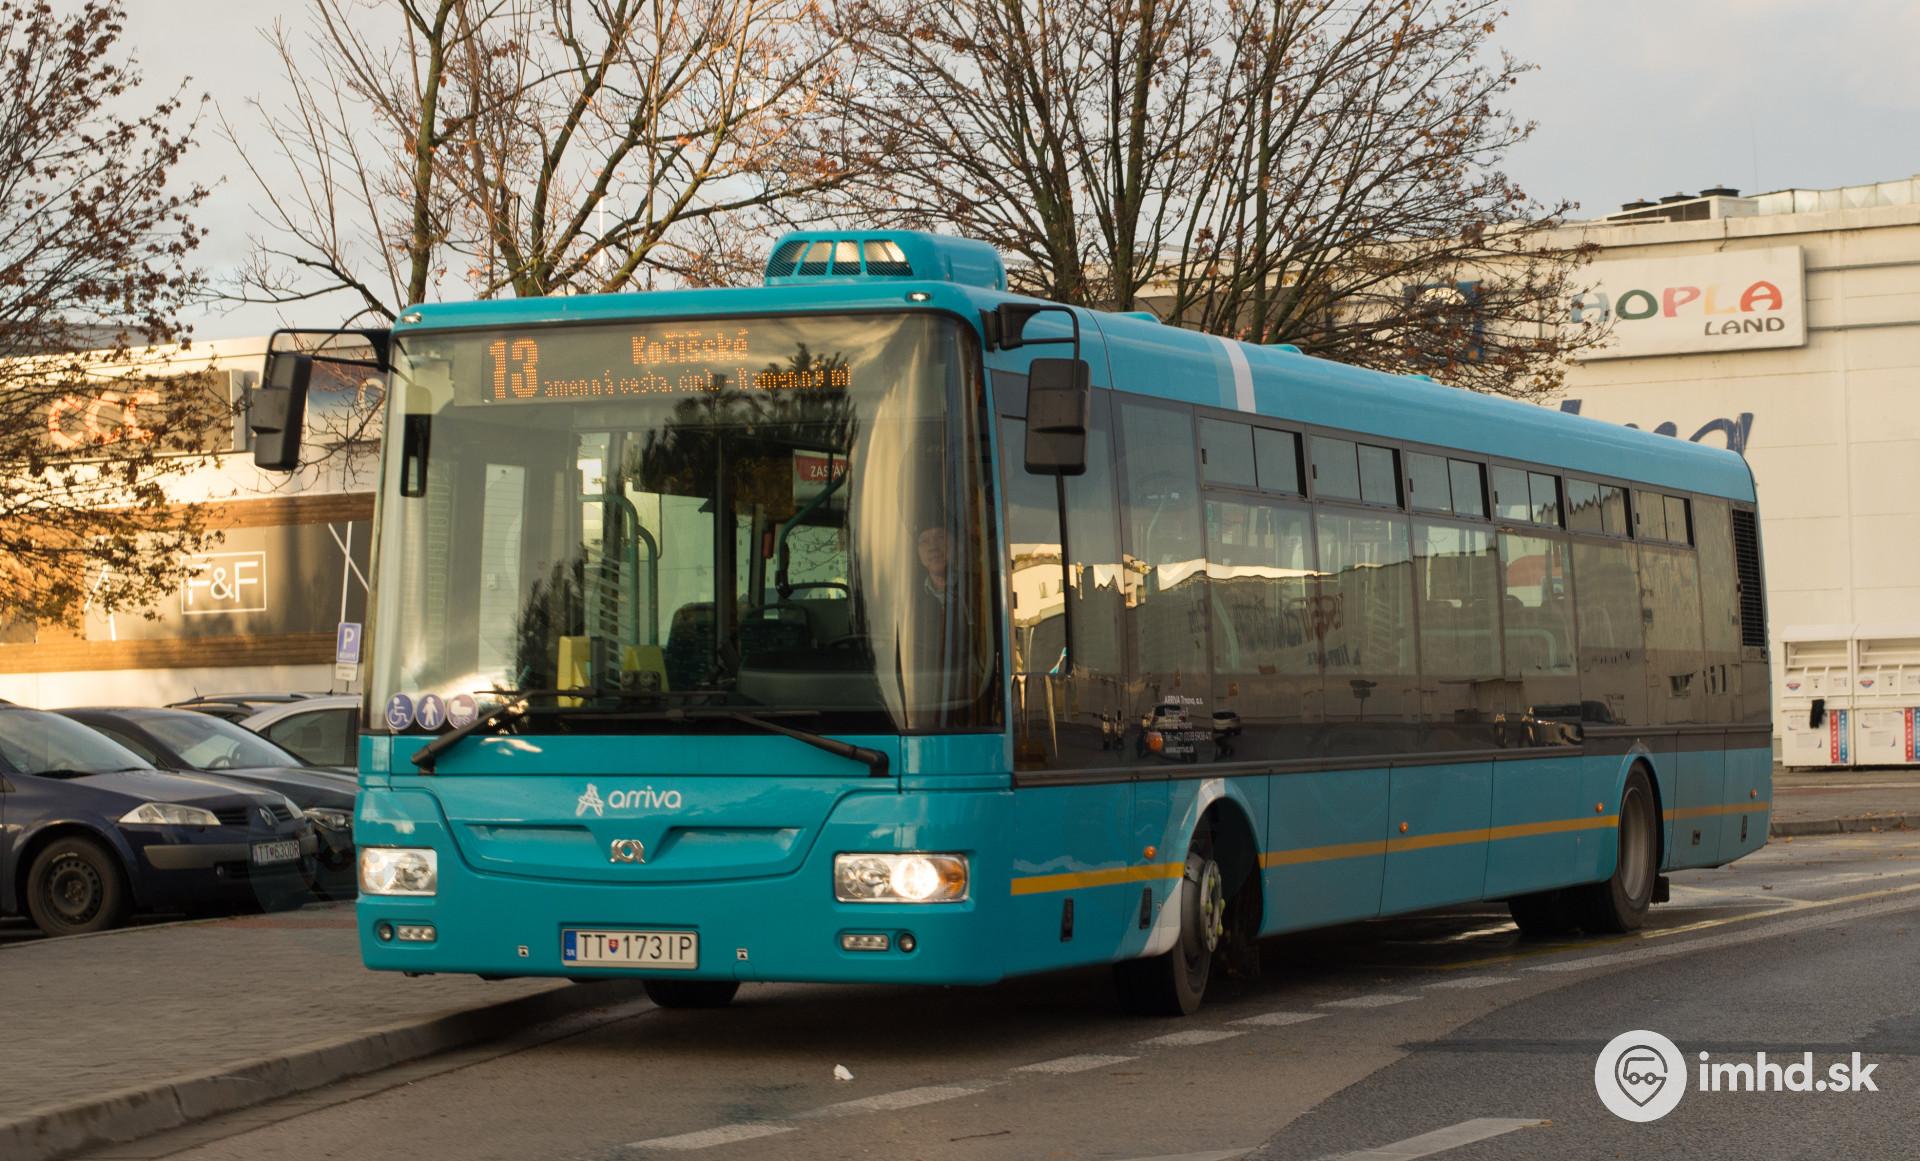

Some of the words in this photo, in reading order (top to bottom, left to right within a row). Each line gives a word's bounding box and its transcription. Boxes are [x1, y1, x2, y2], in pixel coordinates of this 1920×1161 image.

[1704, 317, 1785, 336] LAND
[490, 336, 539, 399] 13
[188, 561, 259, 606] F&F
[343, 628, 355, 650] P
[608, 785, 682, 808] arriva
